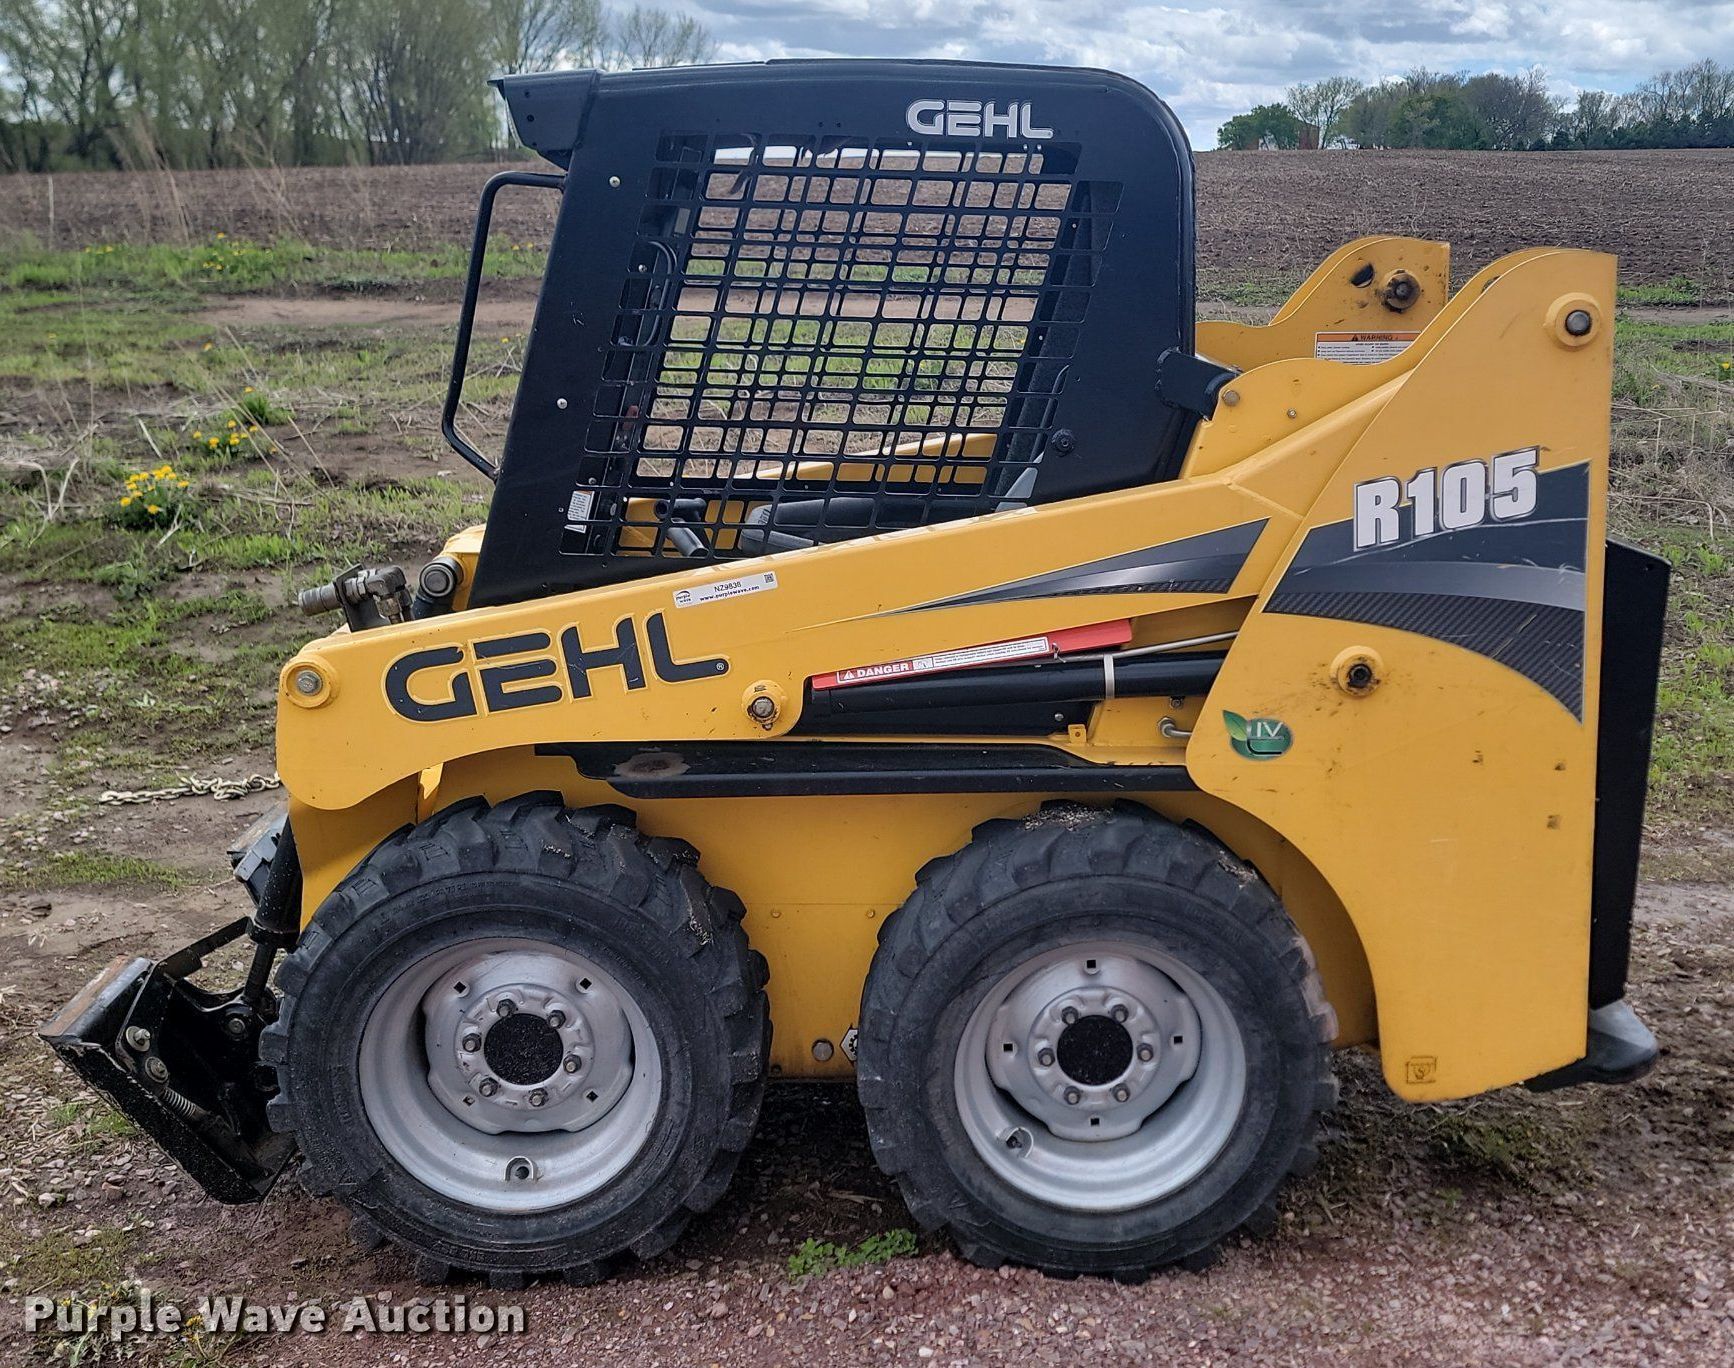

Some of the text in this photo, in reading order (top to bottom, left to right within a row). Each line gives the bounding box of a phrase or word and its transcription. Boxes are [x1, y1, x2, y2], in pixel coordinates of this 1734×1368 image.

[906, 98, 1054, 139] GEHL
[1353, 445, 1540, 552] R105
[699, 585, 760, 602] www.purplewave.com
[383, 611, 731, 723] GEHL
[856, 662, 910, 678] DANGER
